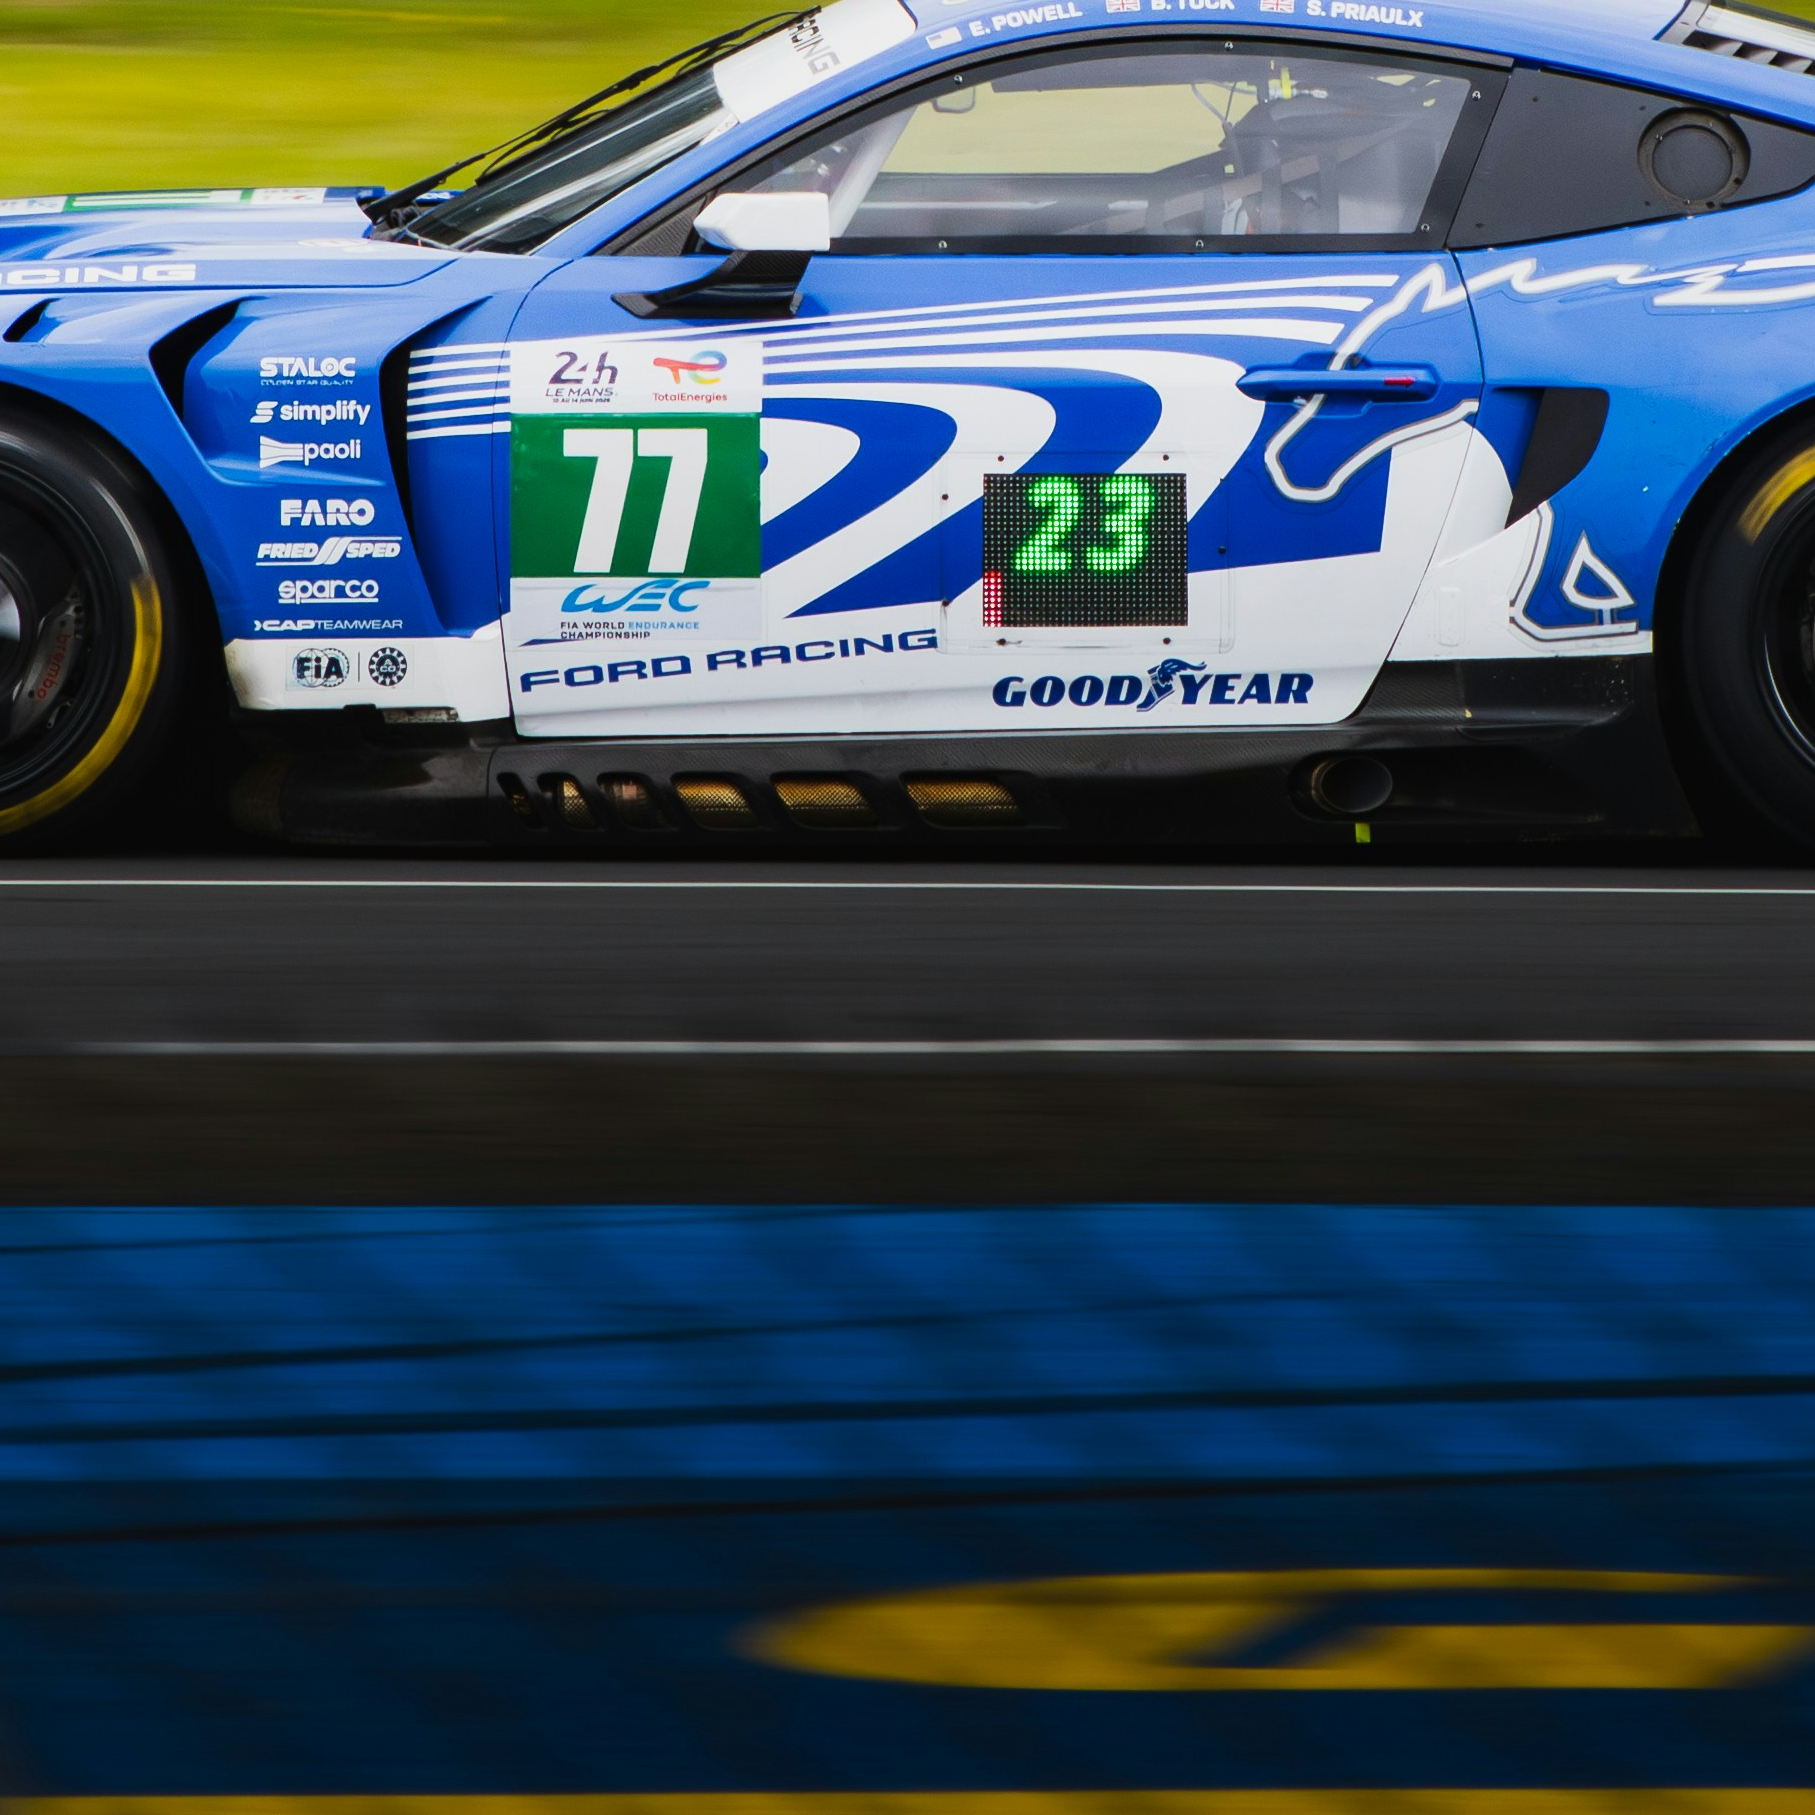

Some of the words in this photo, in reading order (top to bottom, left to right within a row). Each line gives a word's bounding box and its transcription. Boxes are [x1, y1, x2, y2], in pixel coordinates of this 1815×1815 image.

[968, 20, 990, 37] E.
[992, 1, 1083, 31] POWELL
[1306, 0, 1326, 17] S.
[1330, 1, 1424, 28] PRIAULX
[260, 357, 356, 377] STALOC
[545, 387, 565, 397] LE
[568, 387, 614, 397] MANS
[653, 391, 728, 404] TotalEnergies
[280, 399, 371, 426] simplify
[303, 439, 361, 466] paoli
[280, 498, 375, 526] FARO
[563, 428, 708, 574] 77
[1013, 475, 1156, 573] 23
[256, 542, 319, 559] FRIED
[345, 541, 402, 558] SPED
[278, 579, 380, 604] sparco
[560, 578, 711, 613] WEC
[560, 621, 579, 630] FIA
[582, 621, 625, 630] WORLD
[628, 621, 700, 630] ENDURANCE
[560, 631, 651, 639] CHAMPIONSHIP
[520, 655, 692, 693] FORD
[706, 628, 939, 673] RACING
[992, 668, 1315, 710] GOODYEAR
